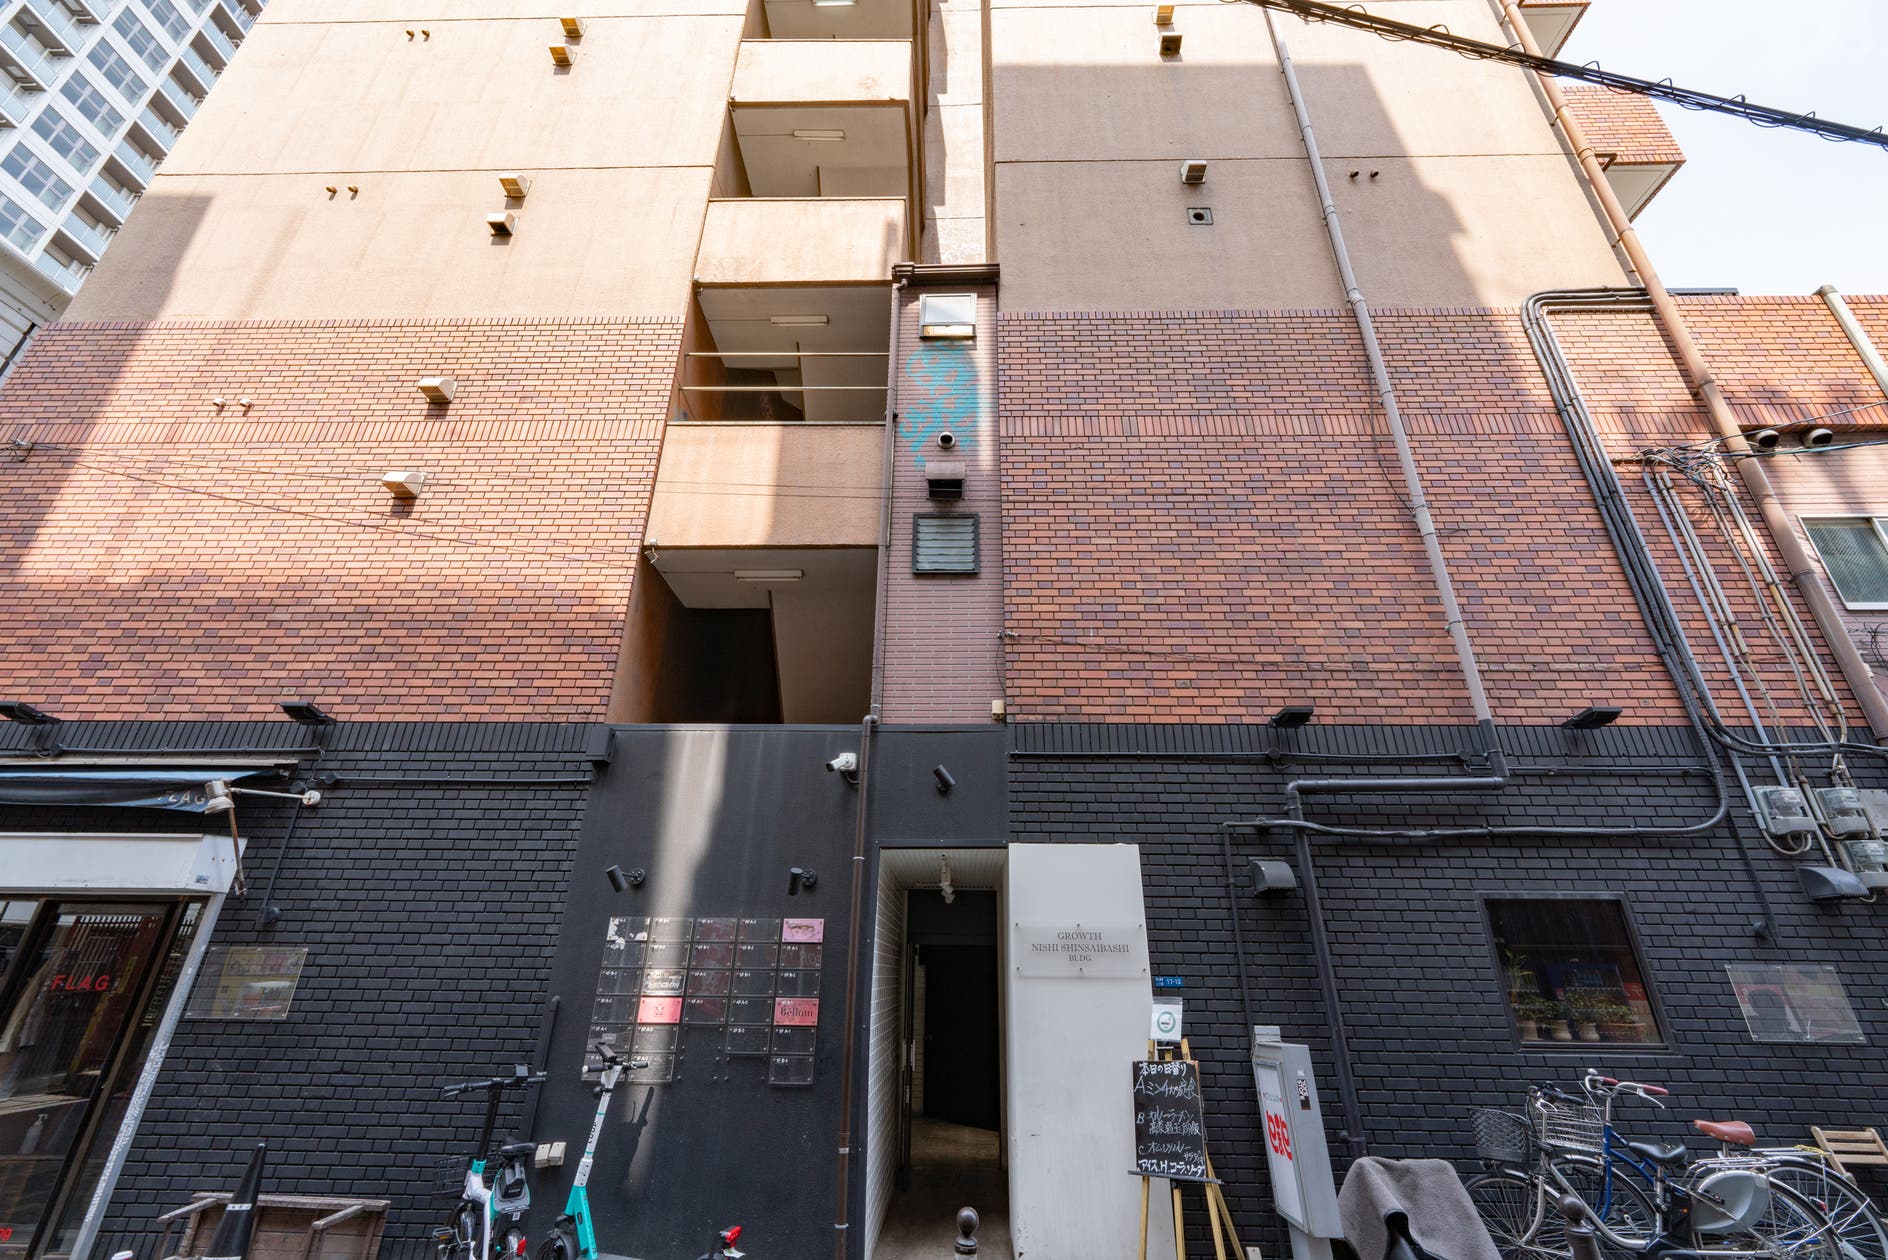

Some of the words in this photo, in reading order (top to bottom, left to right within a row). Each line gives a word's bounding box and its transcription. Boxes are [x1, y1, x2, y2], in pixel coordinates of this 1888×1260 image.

[1057, 931, 1102, 941] GROWTH
[1031, 943, 1059, 952] NISHI
[1060, 943, 1129, 953] SHINSAIBASHI
[50, 973, 111, 991] FLAG
[1133, 1075, 1146, 1094] A
[1136, 1111, 1145, 1125] B
